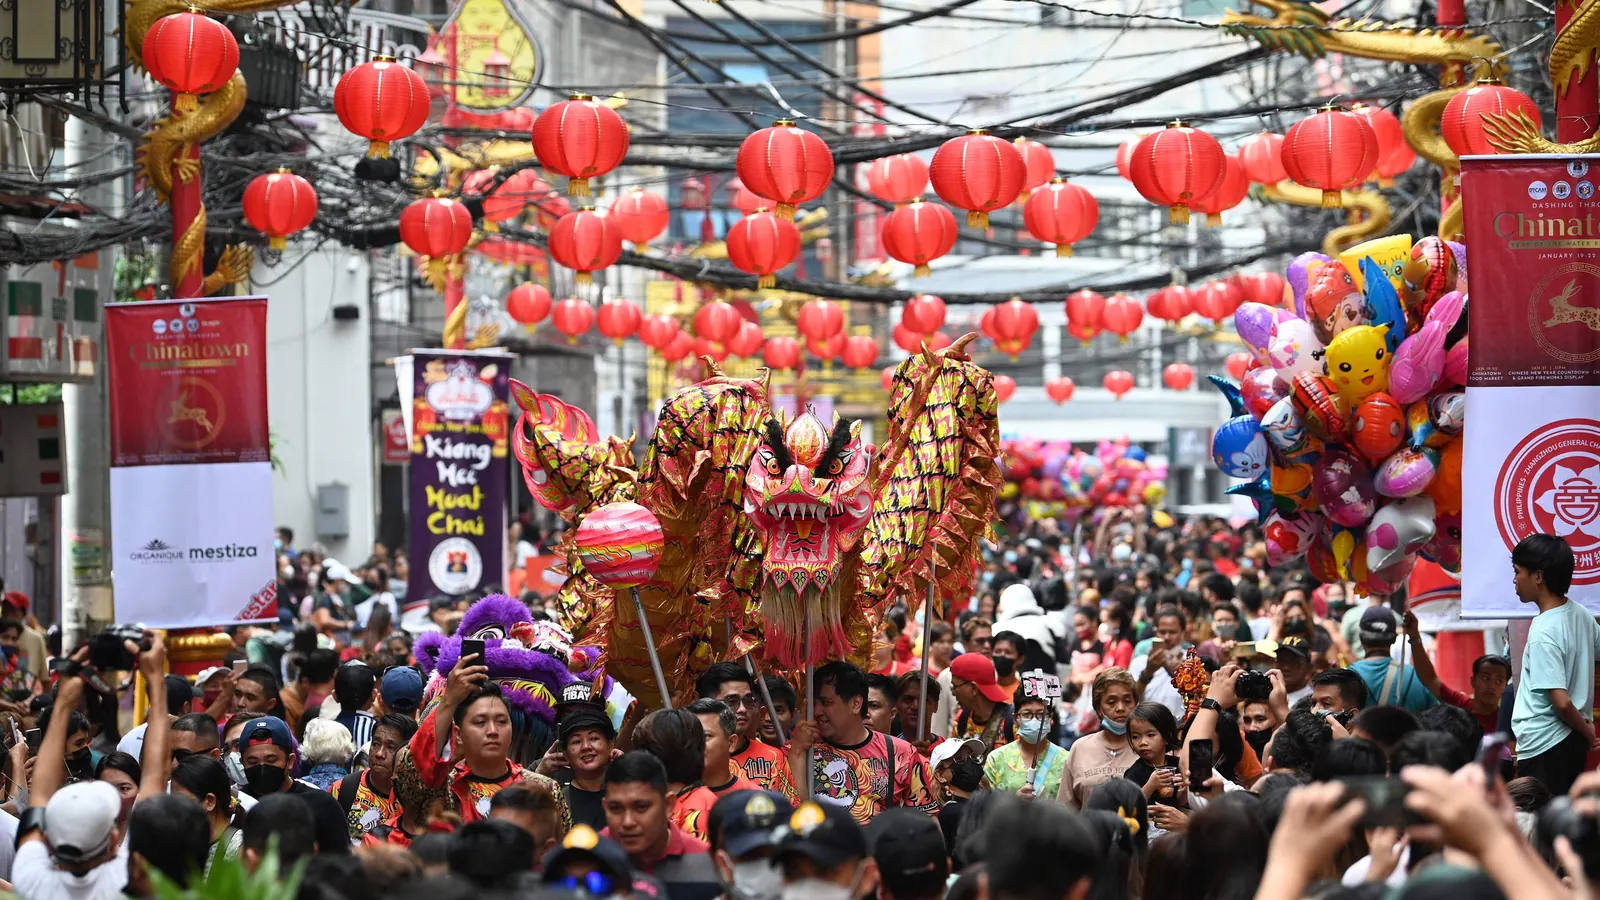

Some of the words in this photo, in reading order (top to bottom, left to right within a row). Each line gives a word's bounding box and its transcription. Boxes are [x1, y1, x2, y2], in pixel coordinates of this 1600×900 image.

[1493, 211, 1600, 238] Chinat
[129, 341, 249, 361] Chinatown
[1516, 477, 1526, 520] PHILIPPINES
[1523, 443, 1558, 476] ZHANGZHOU
[1558, 439, 1588, 449] GENERAL
[425, 485, 485, 511] Huat
[427, 511, 485, 536] Chai
[129, 551, 184, 562] ORGANIQUE
[189, 543, 257, 559] mestiza
[236, 580, 277, 620] estar
[1282, 636, 1301, 646] NY
[563, 691, 591, 701] TIBAY
[564, 684, 591, 694] BARANGAY
[1084, 767, 1107, 778] BELIEVE
